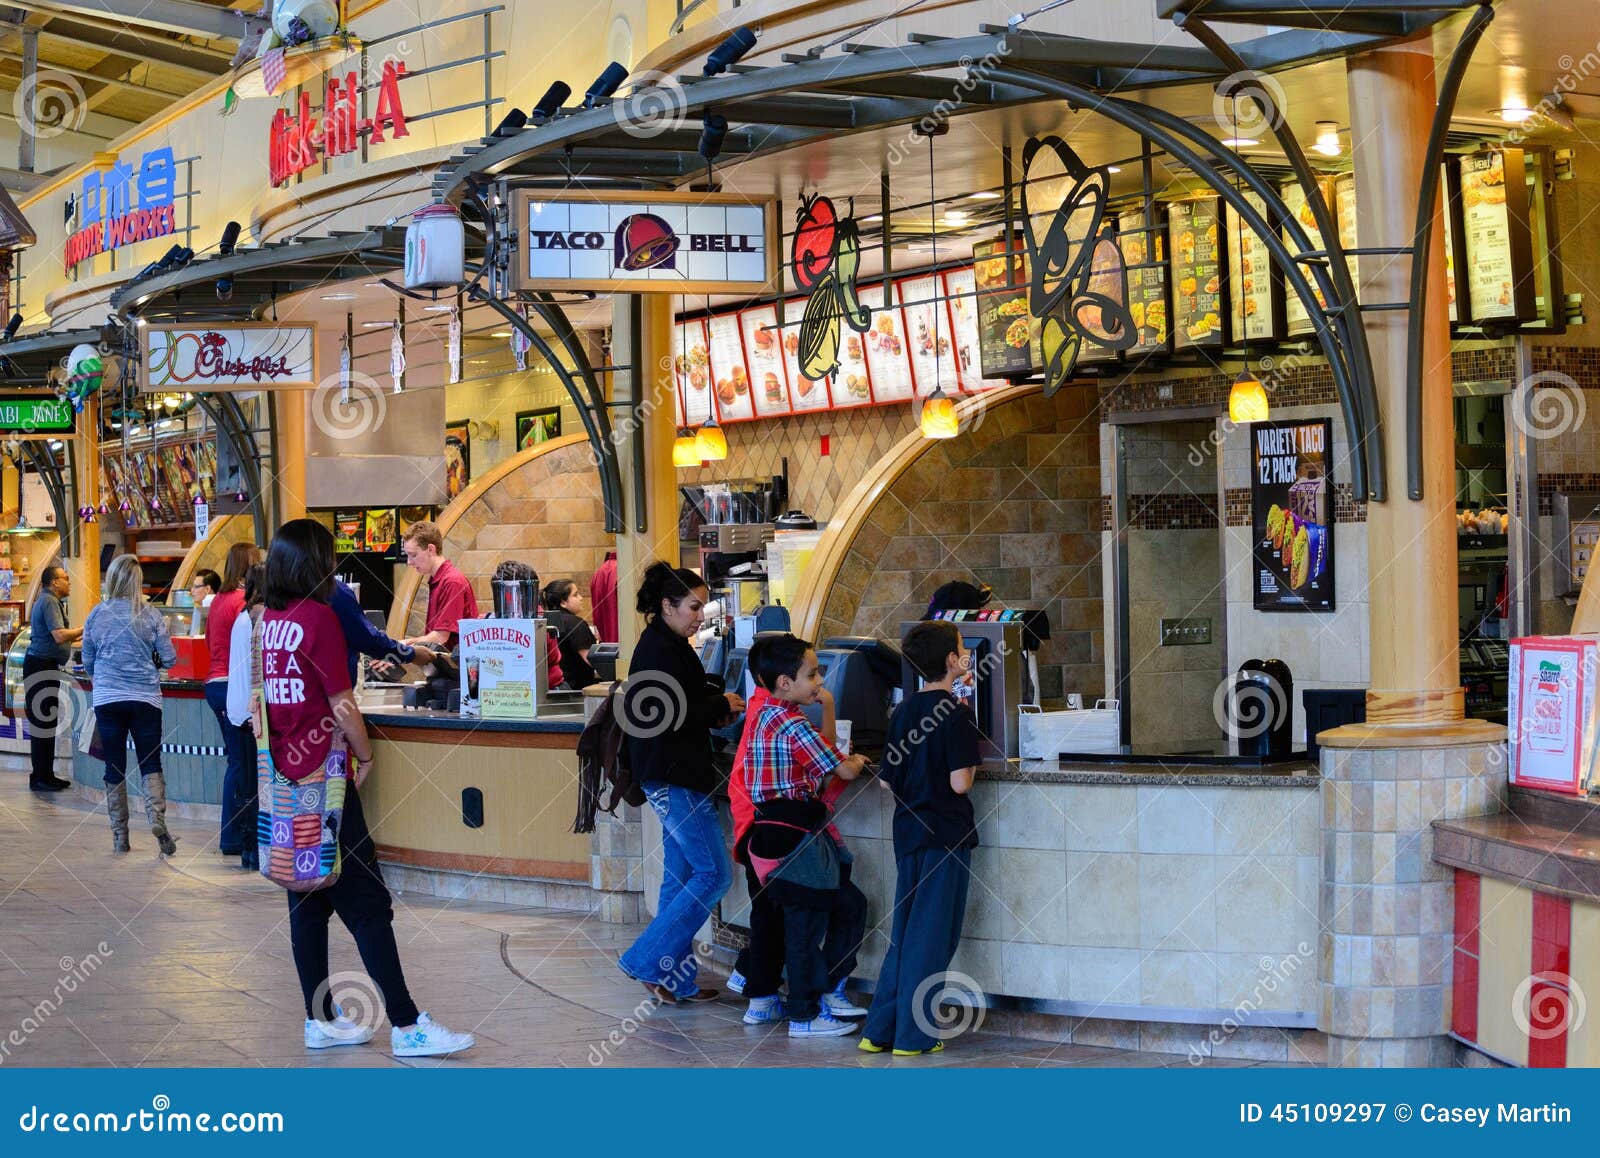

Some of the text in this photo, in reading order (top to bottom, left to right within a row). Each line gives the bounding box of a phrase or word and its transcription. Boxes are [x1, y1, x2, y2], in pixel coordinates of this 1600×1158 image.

[108, 203, 175, 249] WORKS
[531, 230, 757, 252] TACO BELL
[1257, 425, 1325, 456] VARIETY TACO
[1259, 456, 1297, 485] 12 PACK
[261, 619, 304, 652] ROUD
[463, 627, 531, 649] TUMBLERS
[266, 652, 303, 675] BE A
